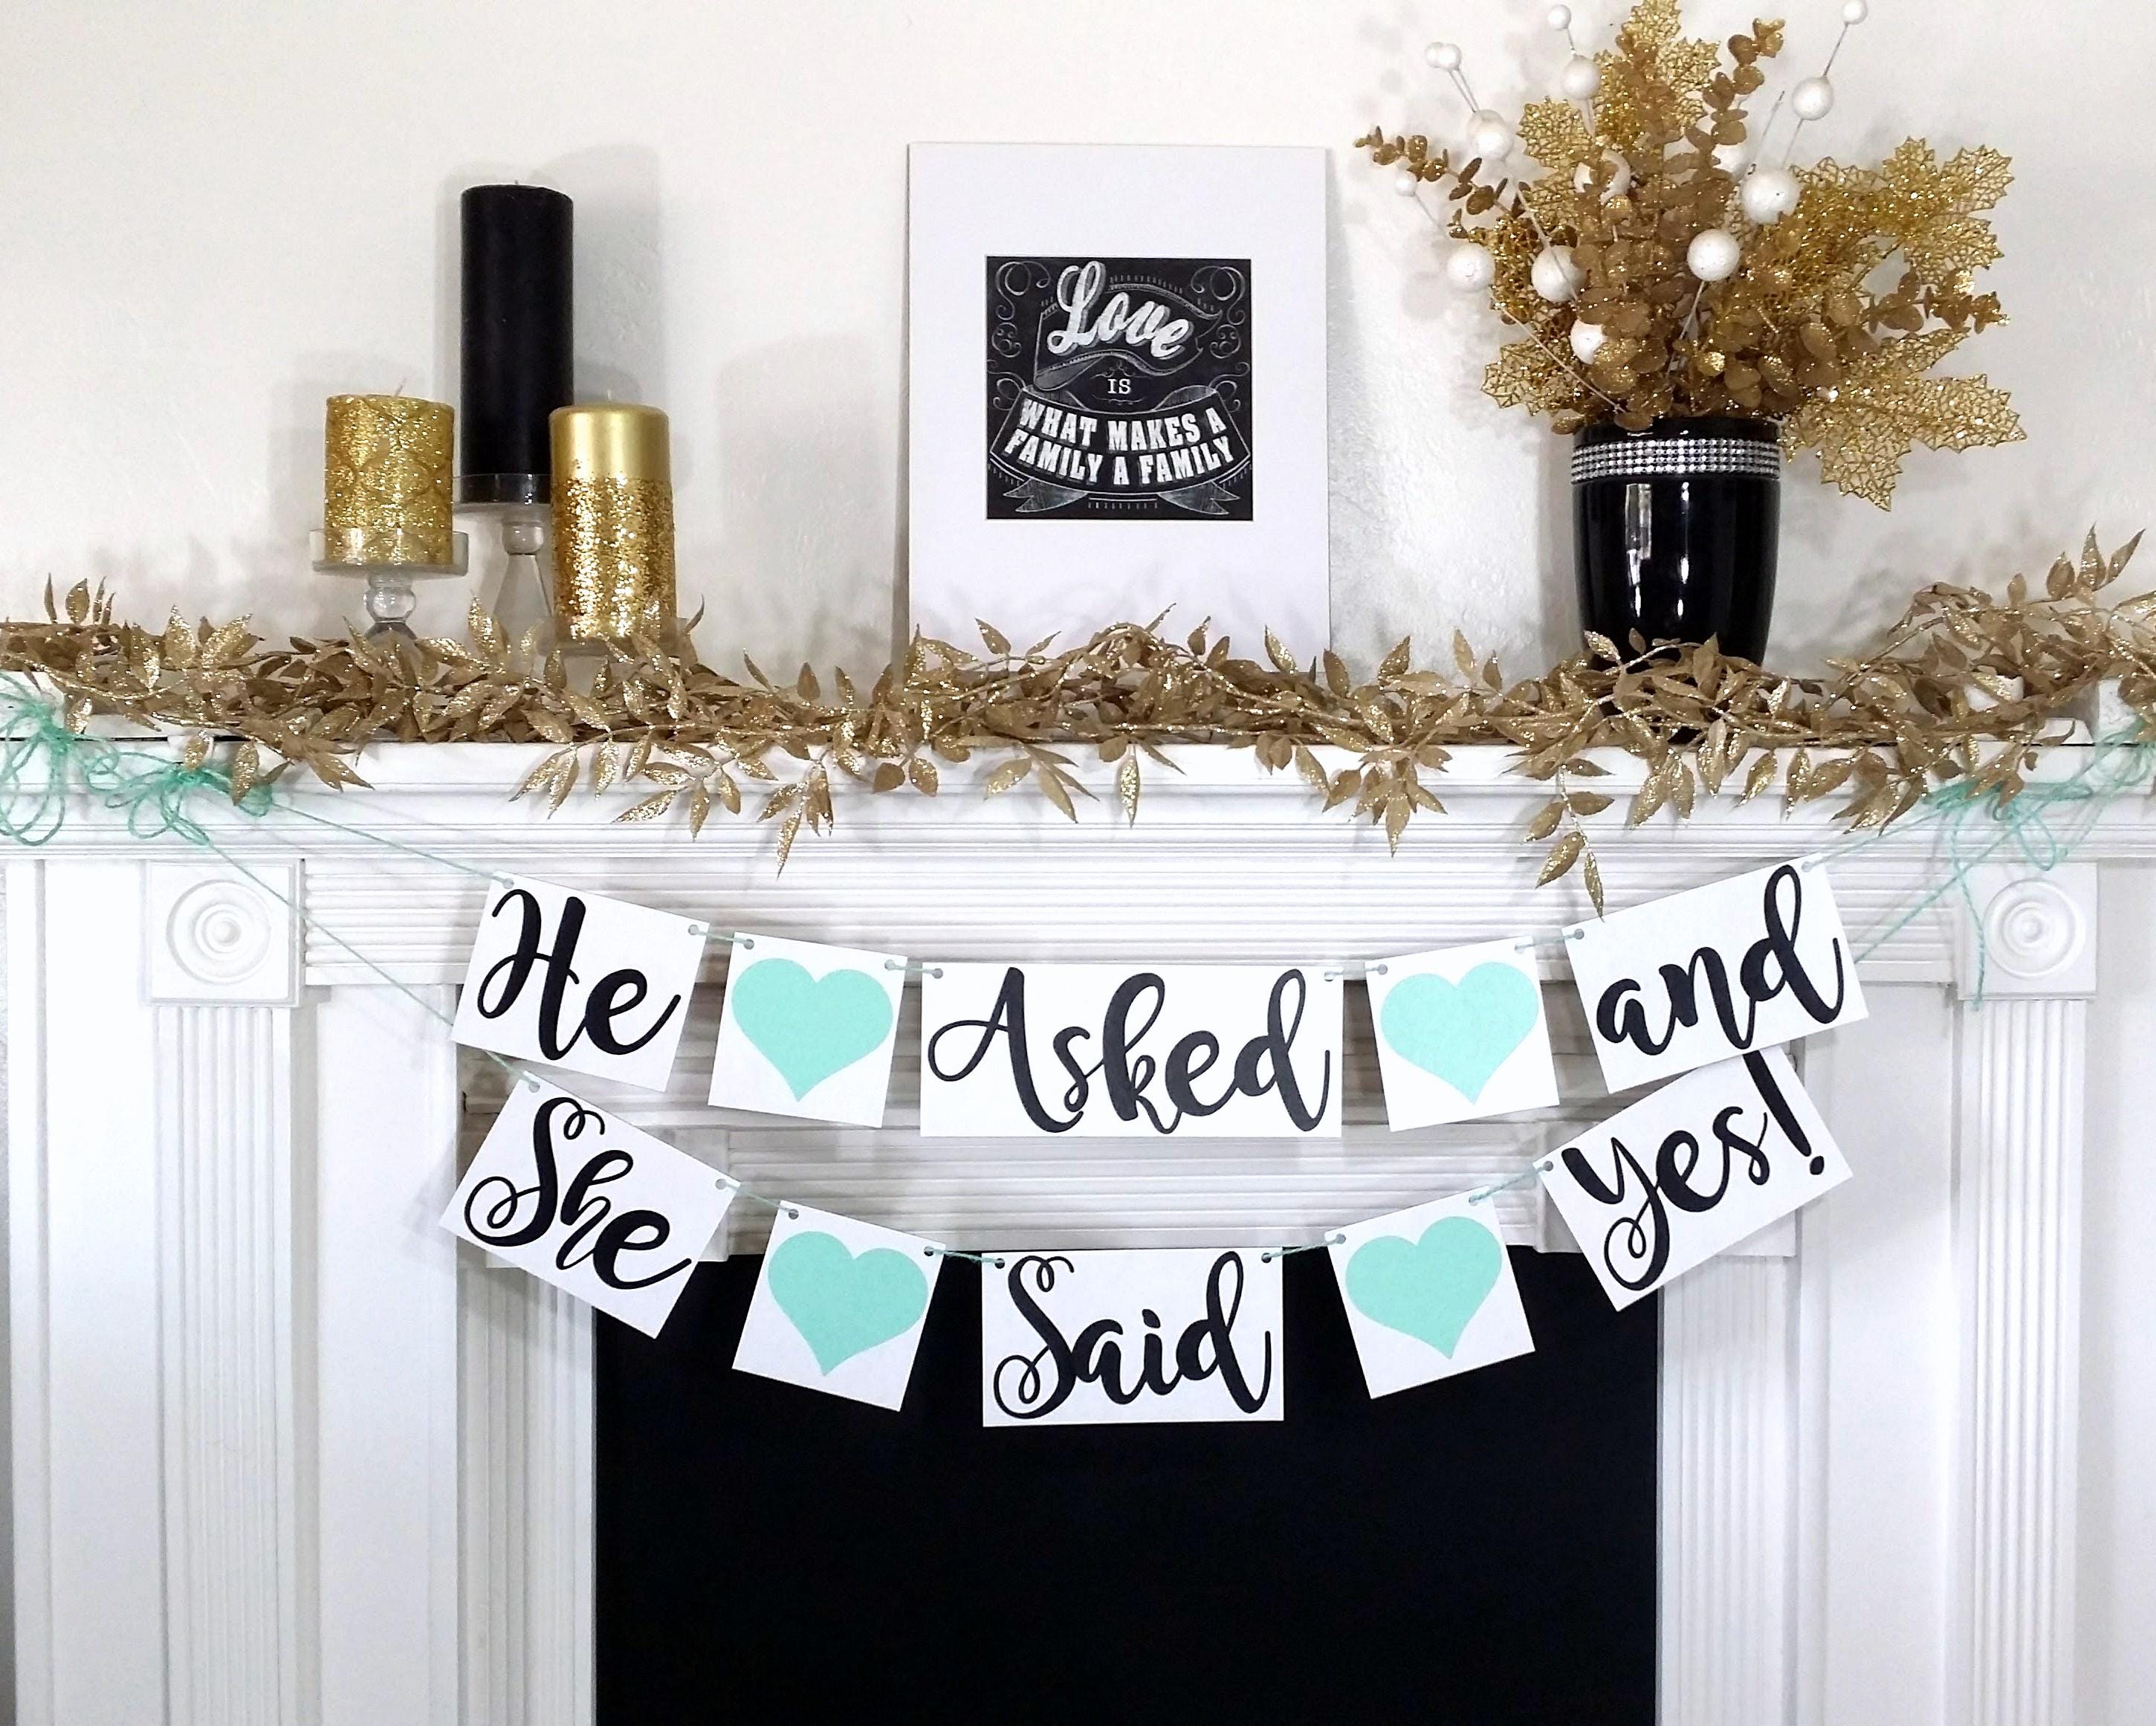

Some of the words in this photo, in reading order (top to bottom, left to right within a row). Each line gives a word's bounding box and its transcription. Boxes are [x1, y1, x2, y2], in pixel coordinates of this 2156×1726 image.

[1046, 261, 1194, 359] Love
[1019, 398, 1098, 447] WHAT
[1107, 416, 1201, 451] MAKES
[1205, 407, 1227, 434] A
[1107, 378, 1131, 395] IS
[1003, 428, 1104, 484] FAMILY
[1113, 456, 1130, 485] A
[1139, 436, 1234, 485] FAMILY
[478, 889, 681, 1060] He
[928, 967, 1330, 1134] Asked
[1597, 864, 1844, 1056] and
[464, 1097, 693, 1289] She
[994, 1251, 1271, 1419] Said
